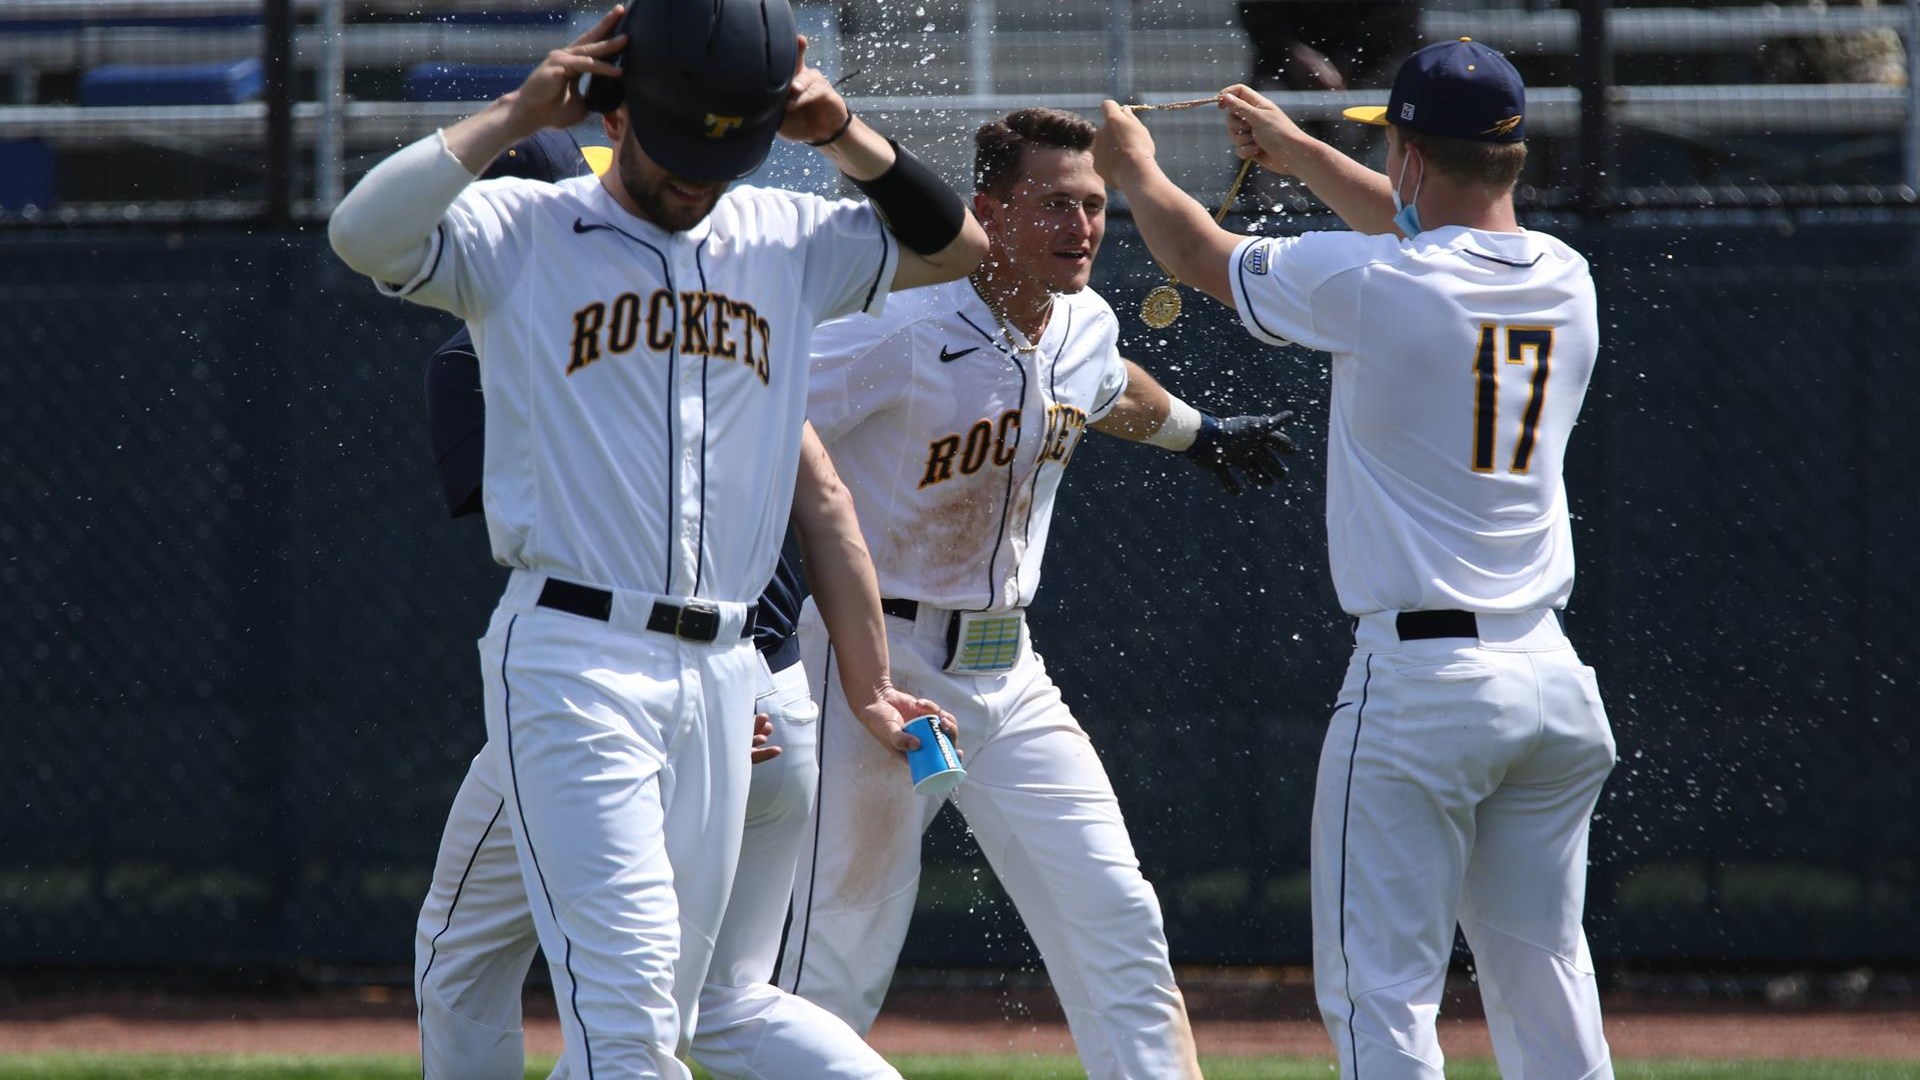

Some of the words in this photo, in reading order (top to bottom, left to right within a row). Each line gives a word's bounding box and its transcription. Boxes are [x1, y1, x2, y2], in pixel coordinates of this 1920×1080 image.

[705, 113, 743, 138] T
[566, 288, 771, 386] ROCKETS
[1472, 323, 1556, 475] 17
